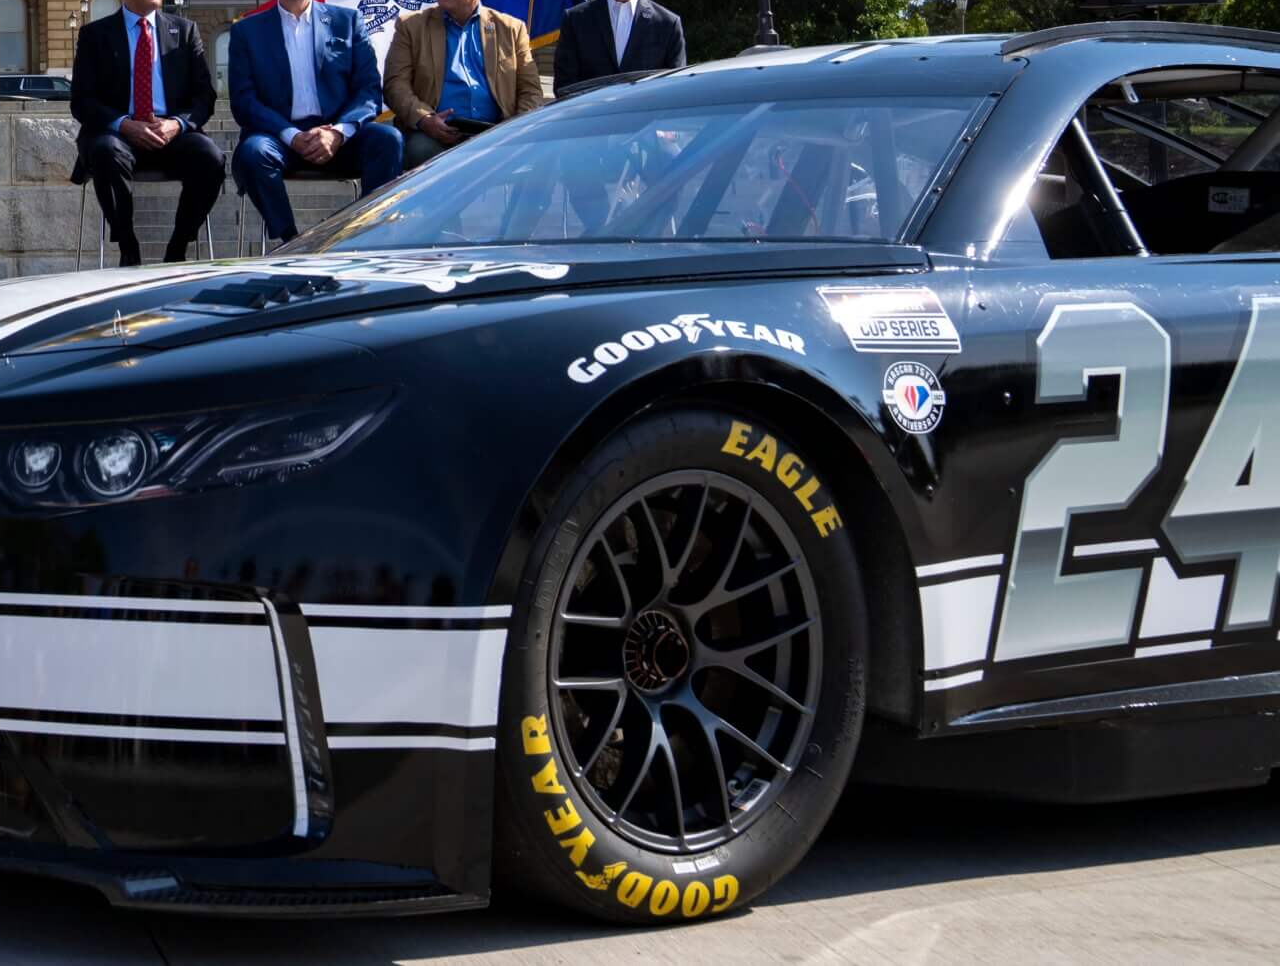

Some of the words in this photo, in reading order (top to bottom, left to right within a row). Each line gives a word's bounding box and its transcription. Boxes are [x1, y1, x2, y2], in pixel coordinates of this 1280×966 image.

[567, 314, 807, 385] GOODYEAR
[860, 321, 888, 337] CUP
[889, 320, 940, 337] SERIES
[887, 364, 913, 385] NASCAR
[892, 407, 939, 431] ANNIVERSARY
[721, 419, 844, 539] EAGLE
[993, 296, 1280, 662] 24
[523, 712, 740, 918] GOODYEAR
